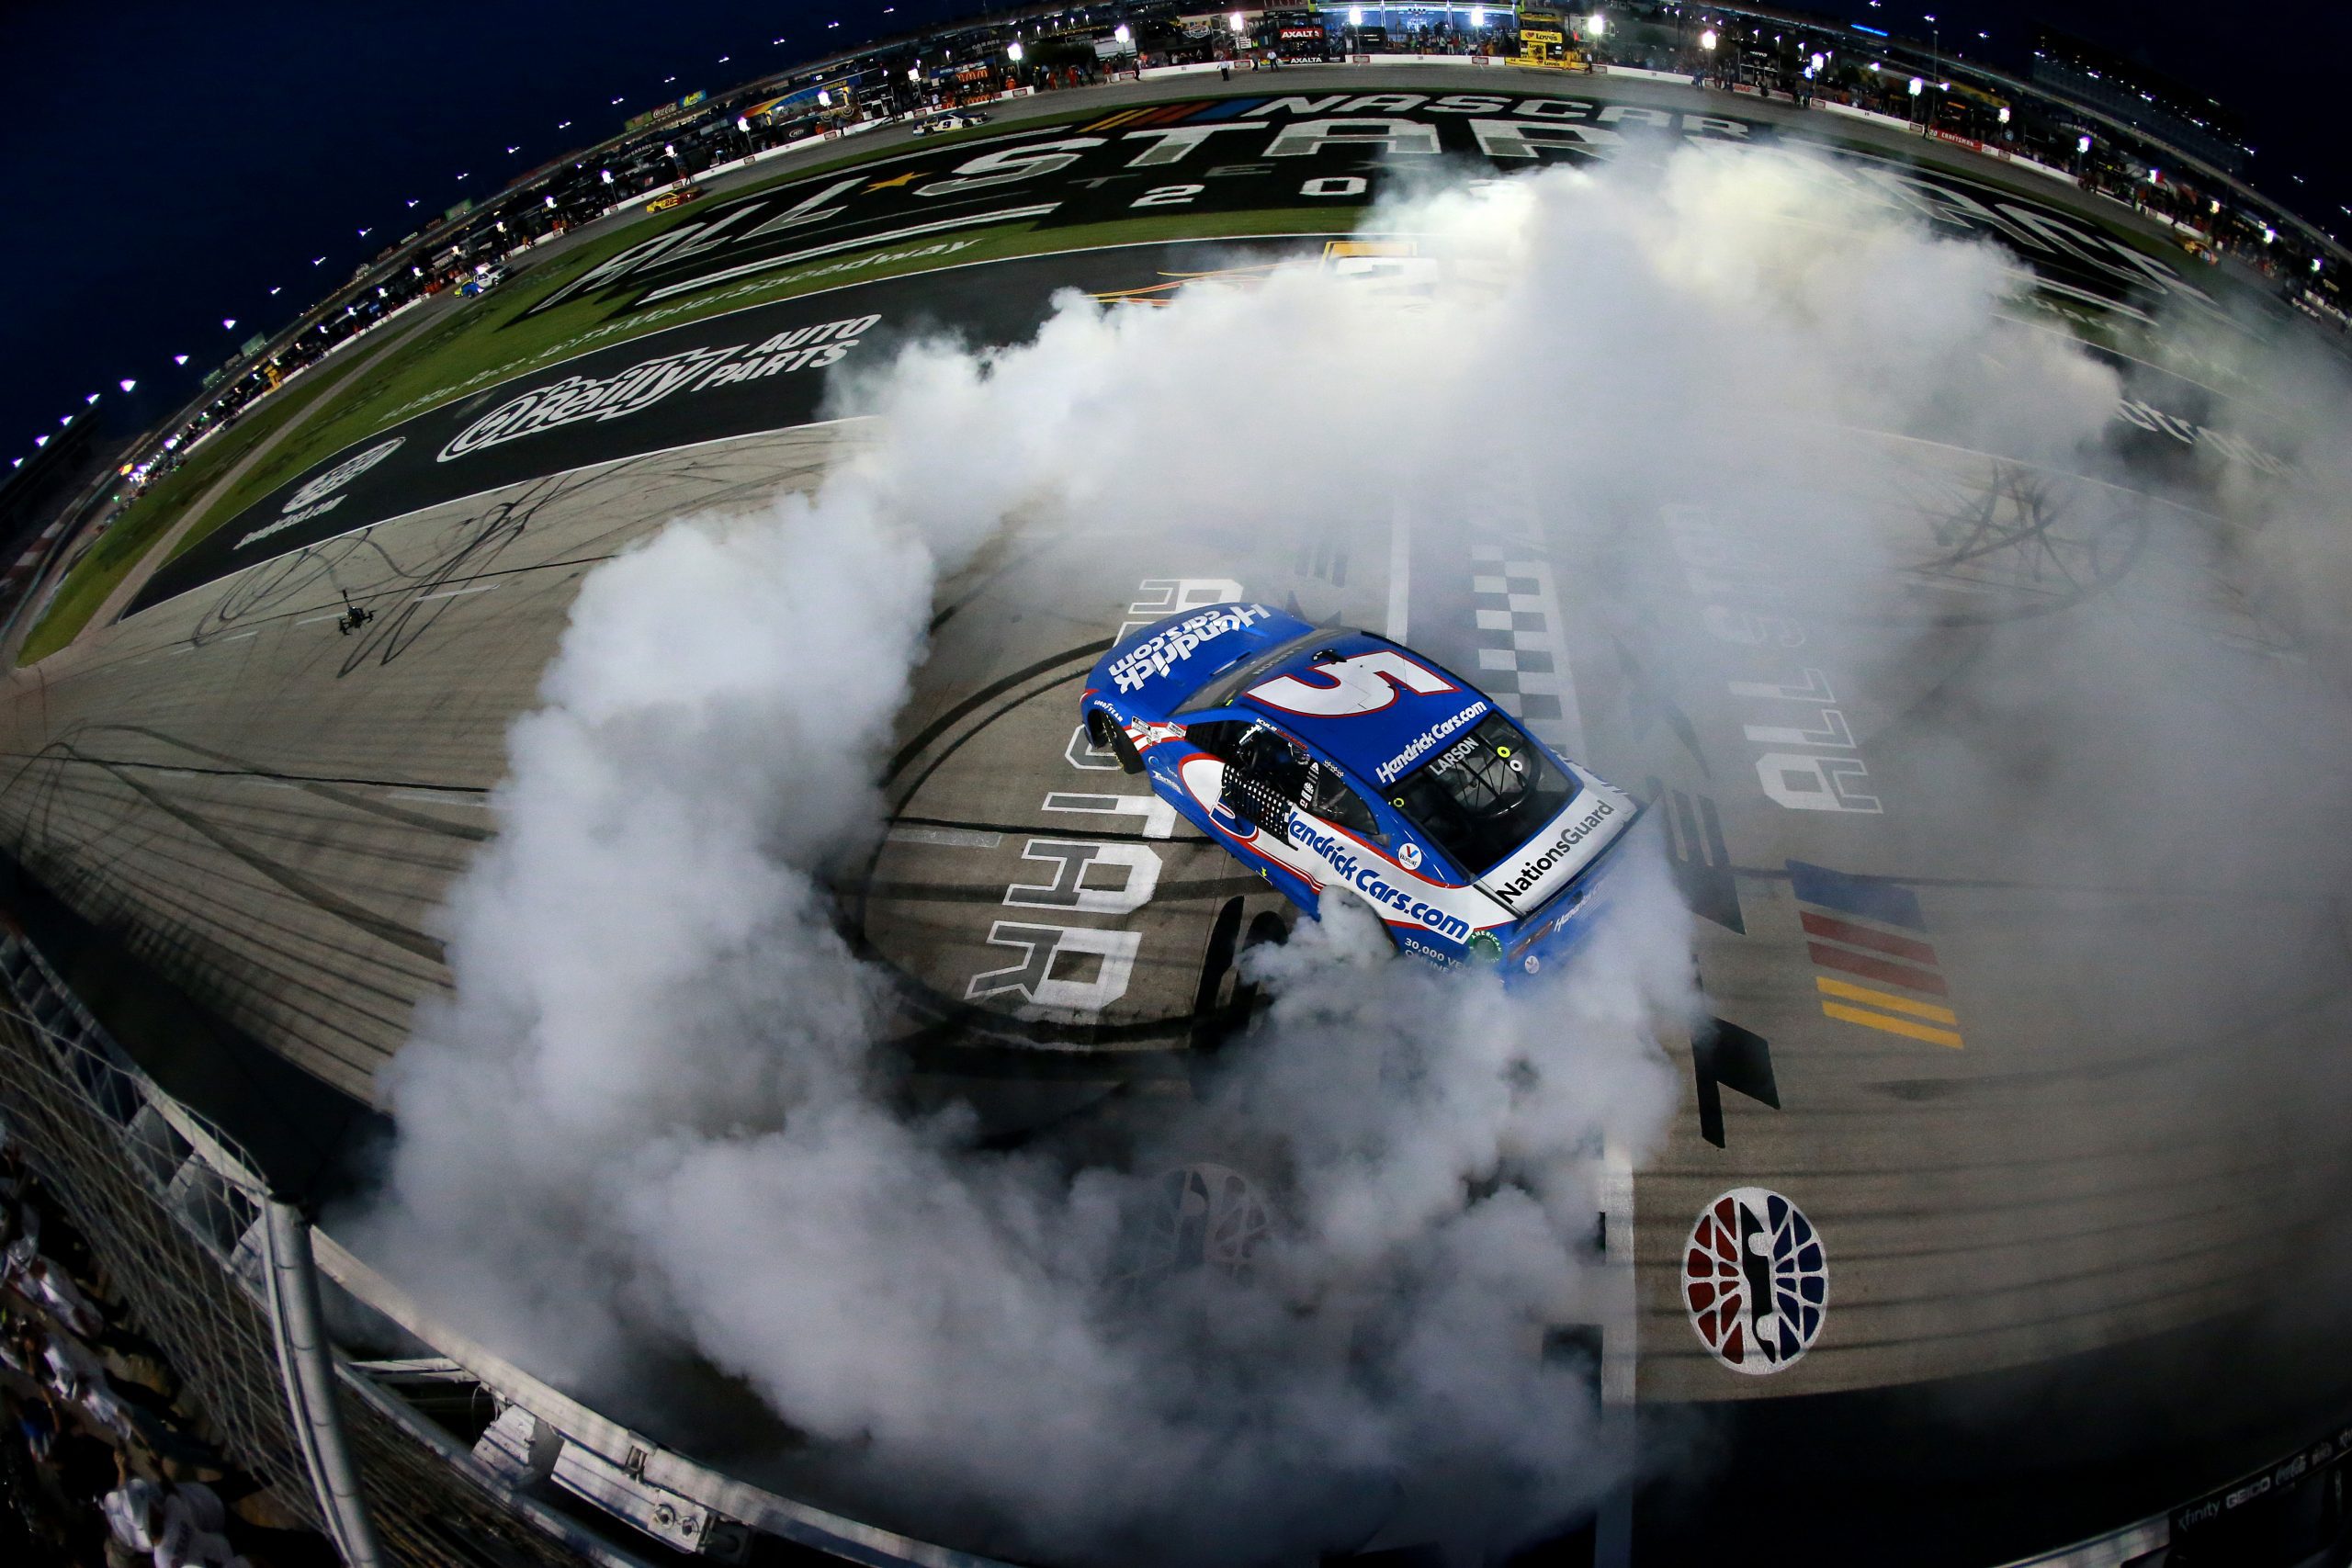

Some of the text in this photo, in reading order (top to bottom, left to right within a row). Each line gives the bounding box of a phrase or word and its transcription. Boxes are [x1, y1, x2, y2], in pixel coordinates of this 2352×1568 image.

[943, 120, 952, 129] 9
[1243, 94, 1749, 140] NASCAR
[1940, 131, 1974, 147] CRAFTSMAN
[531, 118, 1645, 313] ALL STAR
[664, 198, 674, 207] 22
[742, 314, 881, 355] AUTO
[691, 339, 860, 391] PARTS
[1114, 604, 1272, 694] Hendrick
[1247, 649, 1459, 717] 5
[1093, 699, 1124, 723] GOODYEAR
[1429, 737, 1479, 776] LARSON
[1497, 799, 1615, 904] NationsGuard
[1404, 937, 1445, 963] 30,000
[1471, 930, 1503, 953] AMERICAN
[2225, 1476, 2271, 1509] GEICO
[2177, 1499, 2222, 1532] xfinity
